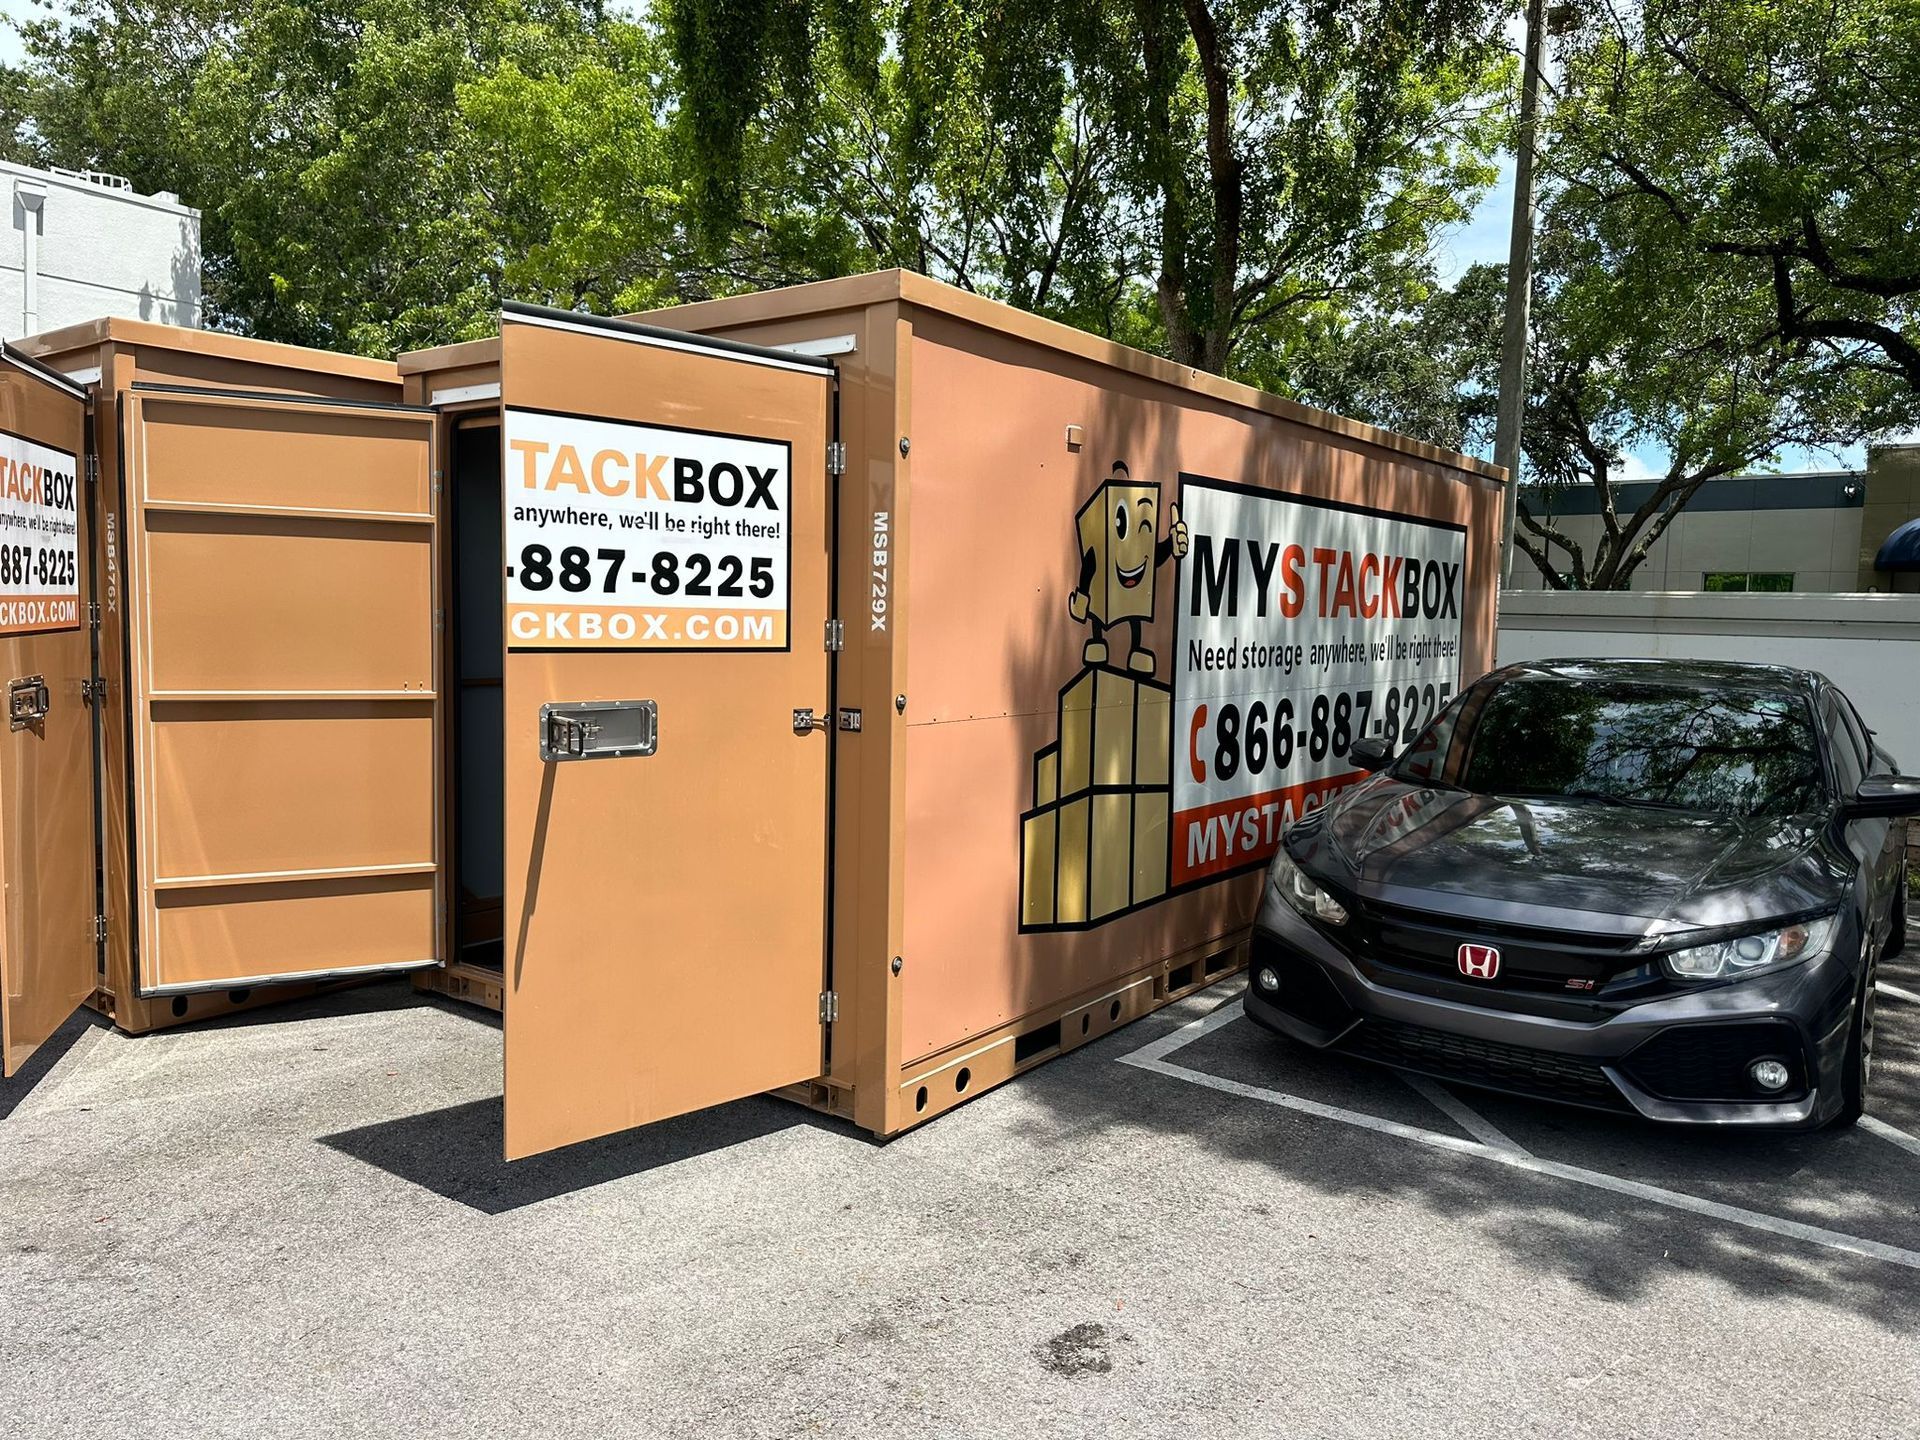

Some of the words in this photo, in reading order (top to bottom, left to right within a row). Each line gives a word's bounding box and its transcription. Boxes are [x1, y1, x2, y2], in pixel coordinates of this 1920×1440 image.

[0, 456, 75, 512] TACKBOX
[510, 438, 780, 511] TACKBOX
[28, 514, 41, 530] we'll
[42, 515, 49, 532] be
[50, 516, 62, 537] right
[513, 506, 613, 530] anywhere,
[619, 511, 659, 530] we'll
[665, 512, 686, 532] be
[691, 515, 730, 539] right
[735, 518, 780, 539] there!
[1, 543, 75, 586] 887-8225
[107, 512, 116, 612] MSB476X
[871, 511, 888, 632] MSB729X
[1190, 534, 1460, 620] MYSTACKBOX
[0, 600, 76, 626] CKBOX.COM
[511, 611, 774, 641] CKBOX.COM
[1188, 637, 1238, 672] Need
[1241, 639, 1303, 675] storage
[1310, 635, 1367, 673] anywhere,
[1370, 635, 1394, 661] we'll
[1395, 634, 1407, 660] be
[1409, 634, 1432, 666] right
[1433, 634, 1458, 658] there!
[1564, 978, 1596, 990] Si
